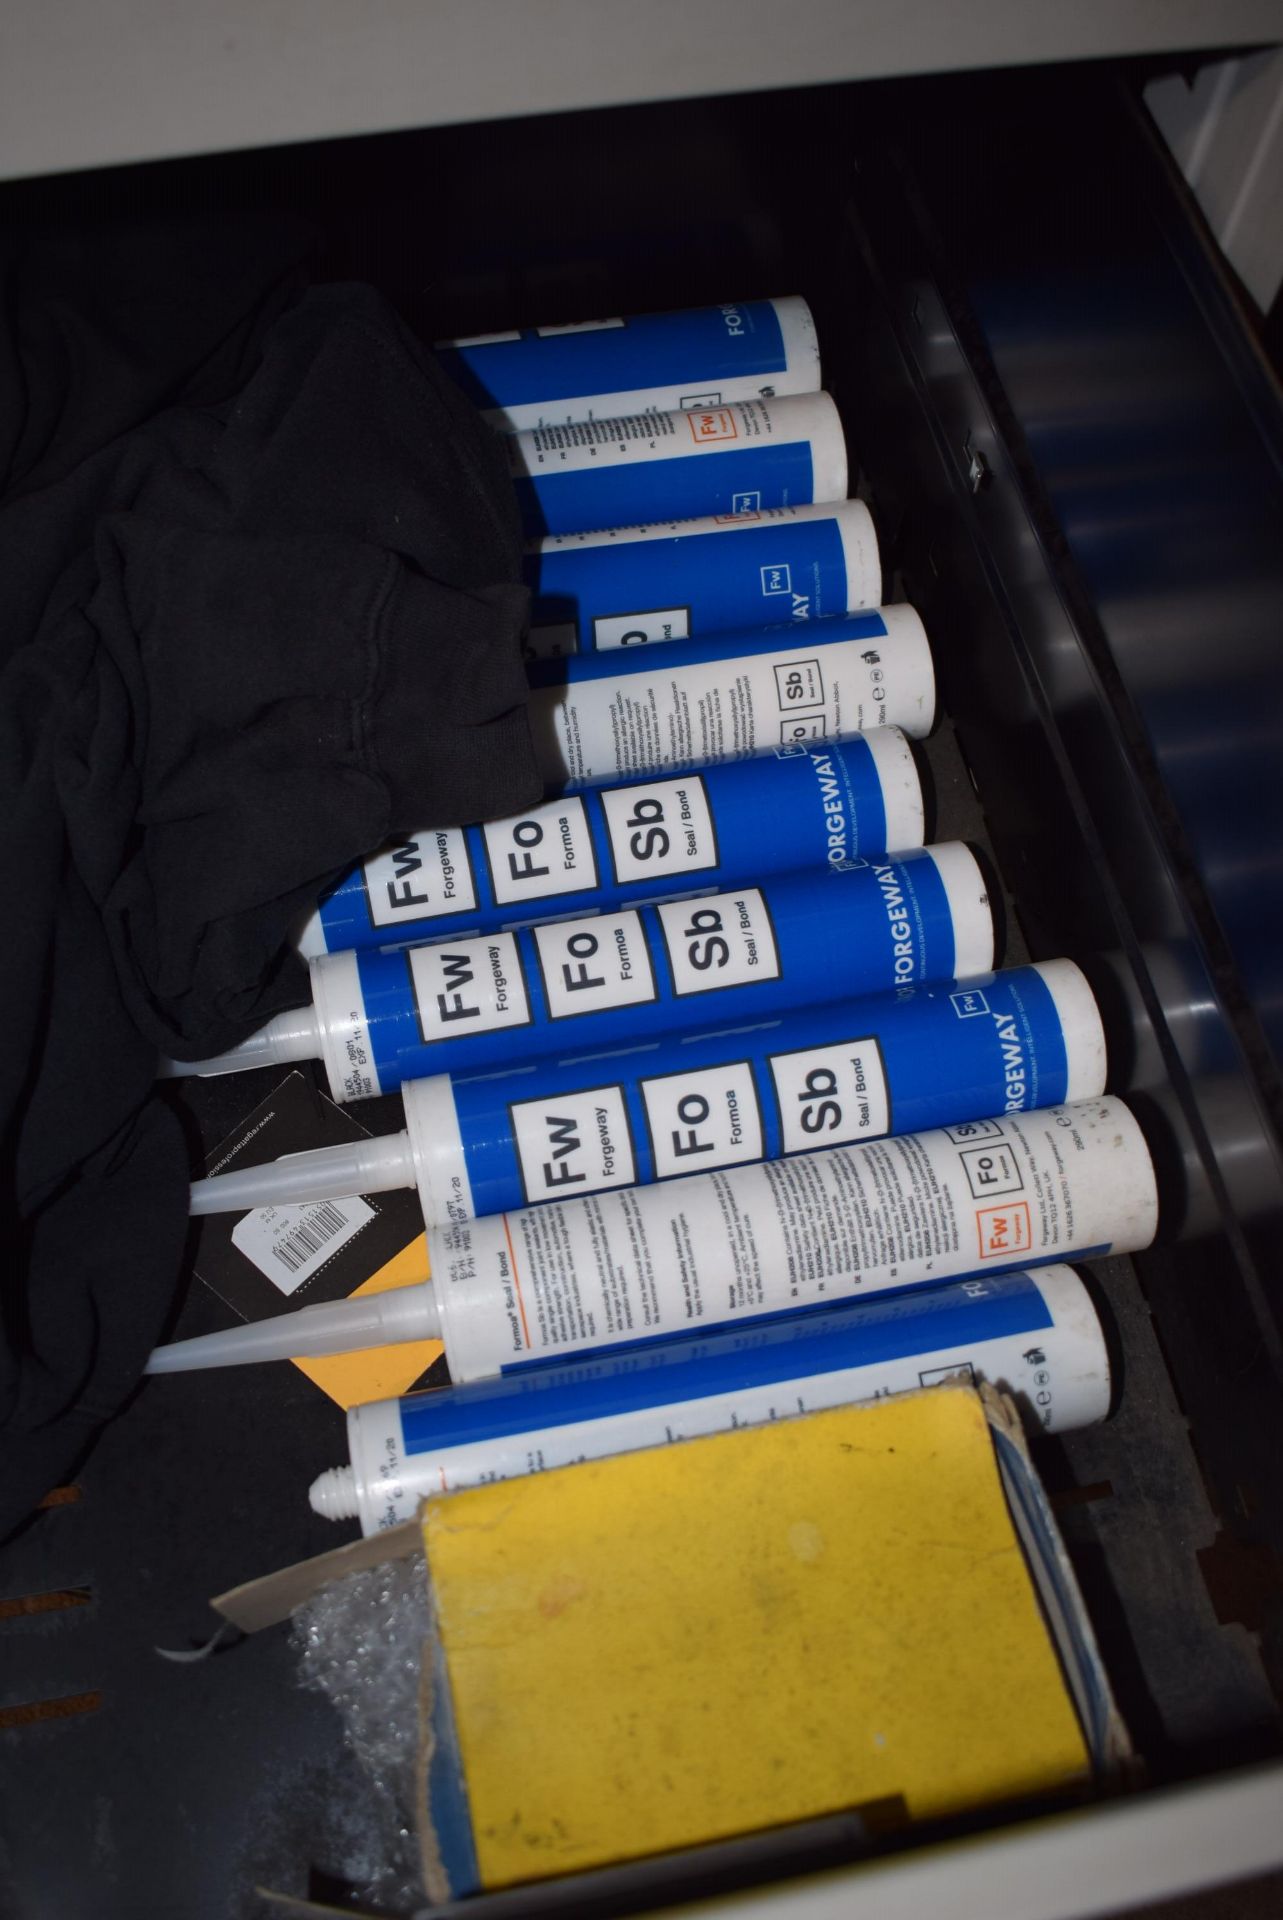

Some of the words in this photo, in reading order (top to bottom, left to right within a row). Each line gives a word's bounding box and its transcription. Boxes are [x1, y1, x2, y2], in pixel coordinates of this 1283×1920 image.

[701, 415, 716, 435] Fw
[770, 571, 781, 589] Fw
[786, 672, 803, 699] Sb
[628, 799, 669, 860] Sb
[676, 790, 691, 820] Bond
[812, 755, 845, 862] ORGEWAY
[435, 830, 455, 898] Forgeway
[509, 821, 549, 880] Fo
[559, 817, 576, 869] Formoa
[685, 830, 697, 856] Seal
[389, 840, 429, 908] Fw
[685, 910, 729, 970] Sb
[734, 901, 751, 928] Bond
[874, 866, 913, 983] FORGEWAY
[563, 933, 605, 991] Fo
[614, 929, 632, 980] Formoa
[744, 939, 758, 965] Seal
[438, 955, 479, 1021] Fw
[488, 946, 508, 1011] Forgeway
[963, 996, 977, 1011] Fw
[850, 1058, 866, 1092] Bond
[672, 1094, 714, 1156] Fo
[726, 1090, 742, 1145] Formoa
[799, 1069, 841, 1133] Sb
[858, 1103, 870, 1127] Seal
[544, 1117, 585, 1187] Fw
[596, 1108, 615, 1176] Forgeway
[999, 1155, 1010, 1179] Formoa
[978, 1157, 998, 1184] Fo
[990, 1218, 1008, 1249] Fw
[497, 1251, 509, 1277] Bond
[504, 1286, 515, 1309] Seal
